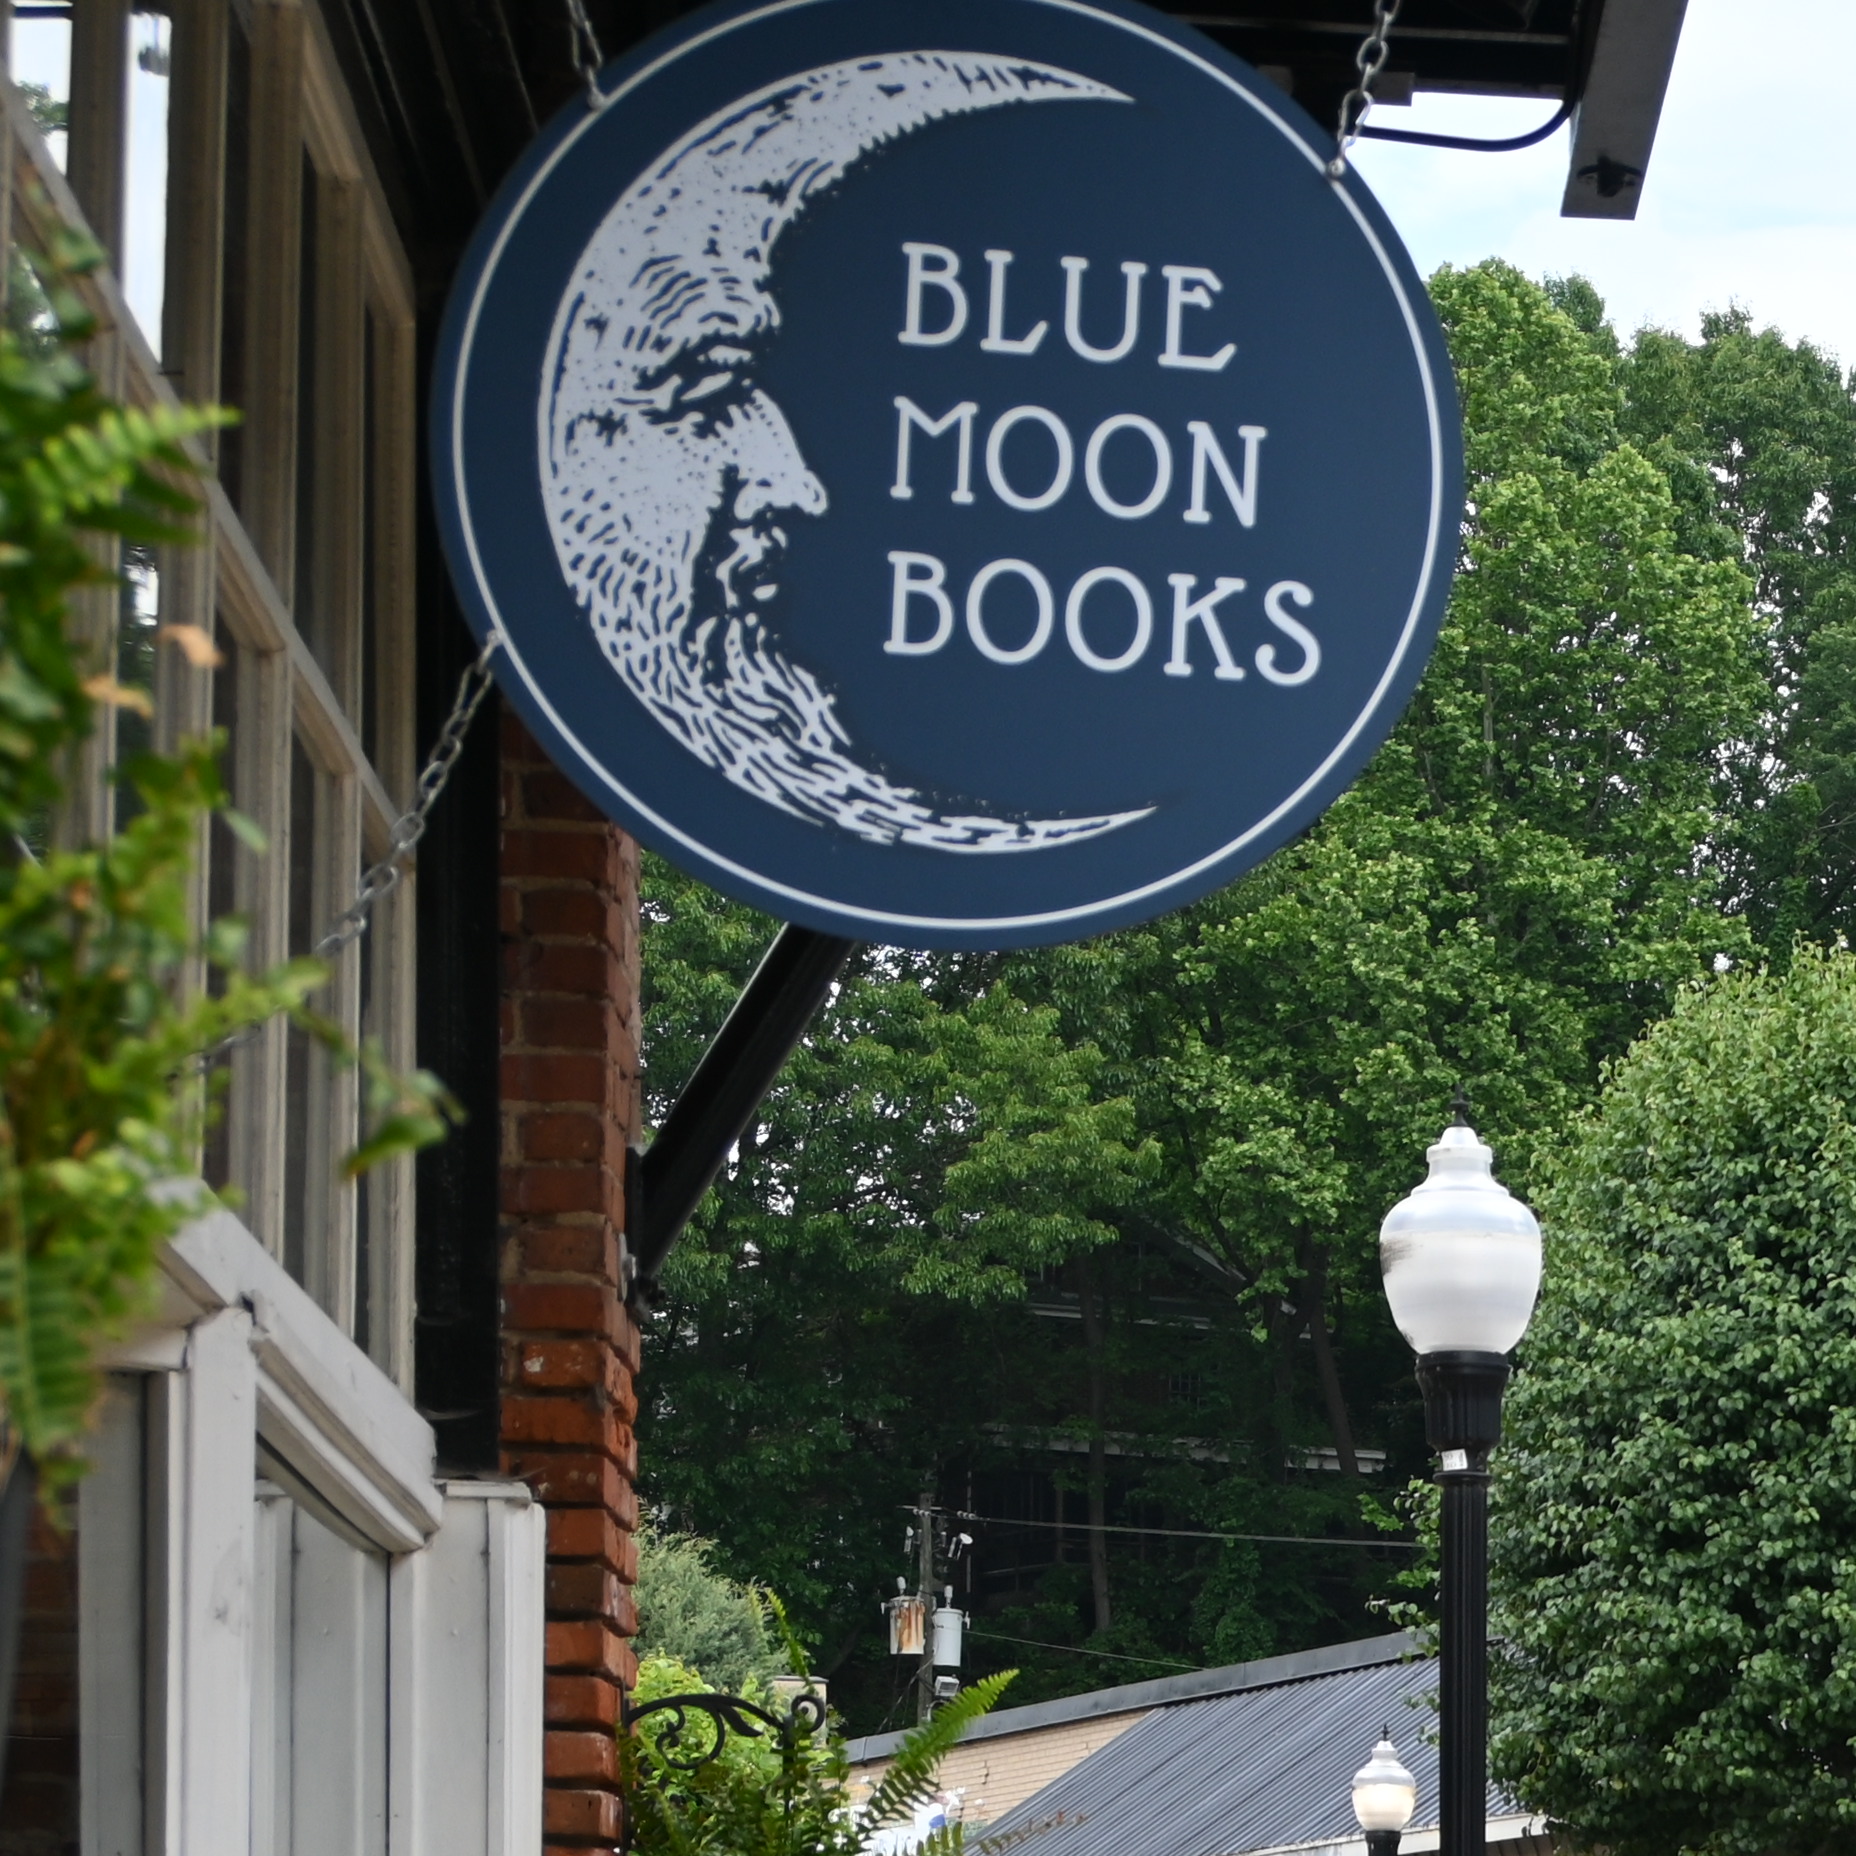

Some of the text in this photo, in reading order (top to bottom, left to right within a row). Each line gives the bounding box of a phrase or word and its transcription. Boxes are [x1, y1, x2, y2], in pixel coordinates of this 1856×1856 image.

[898, 241, 1237, 373] BLUE
[889, 396, 1268, 529] MOON
[883, 551, 1322, 688] BOOKS
